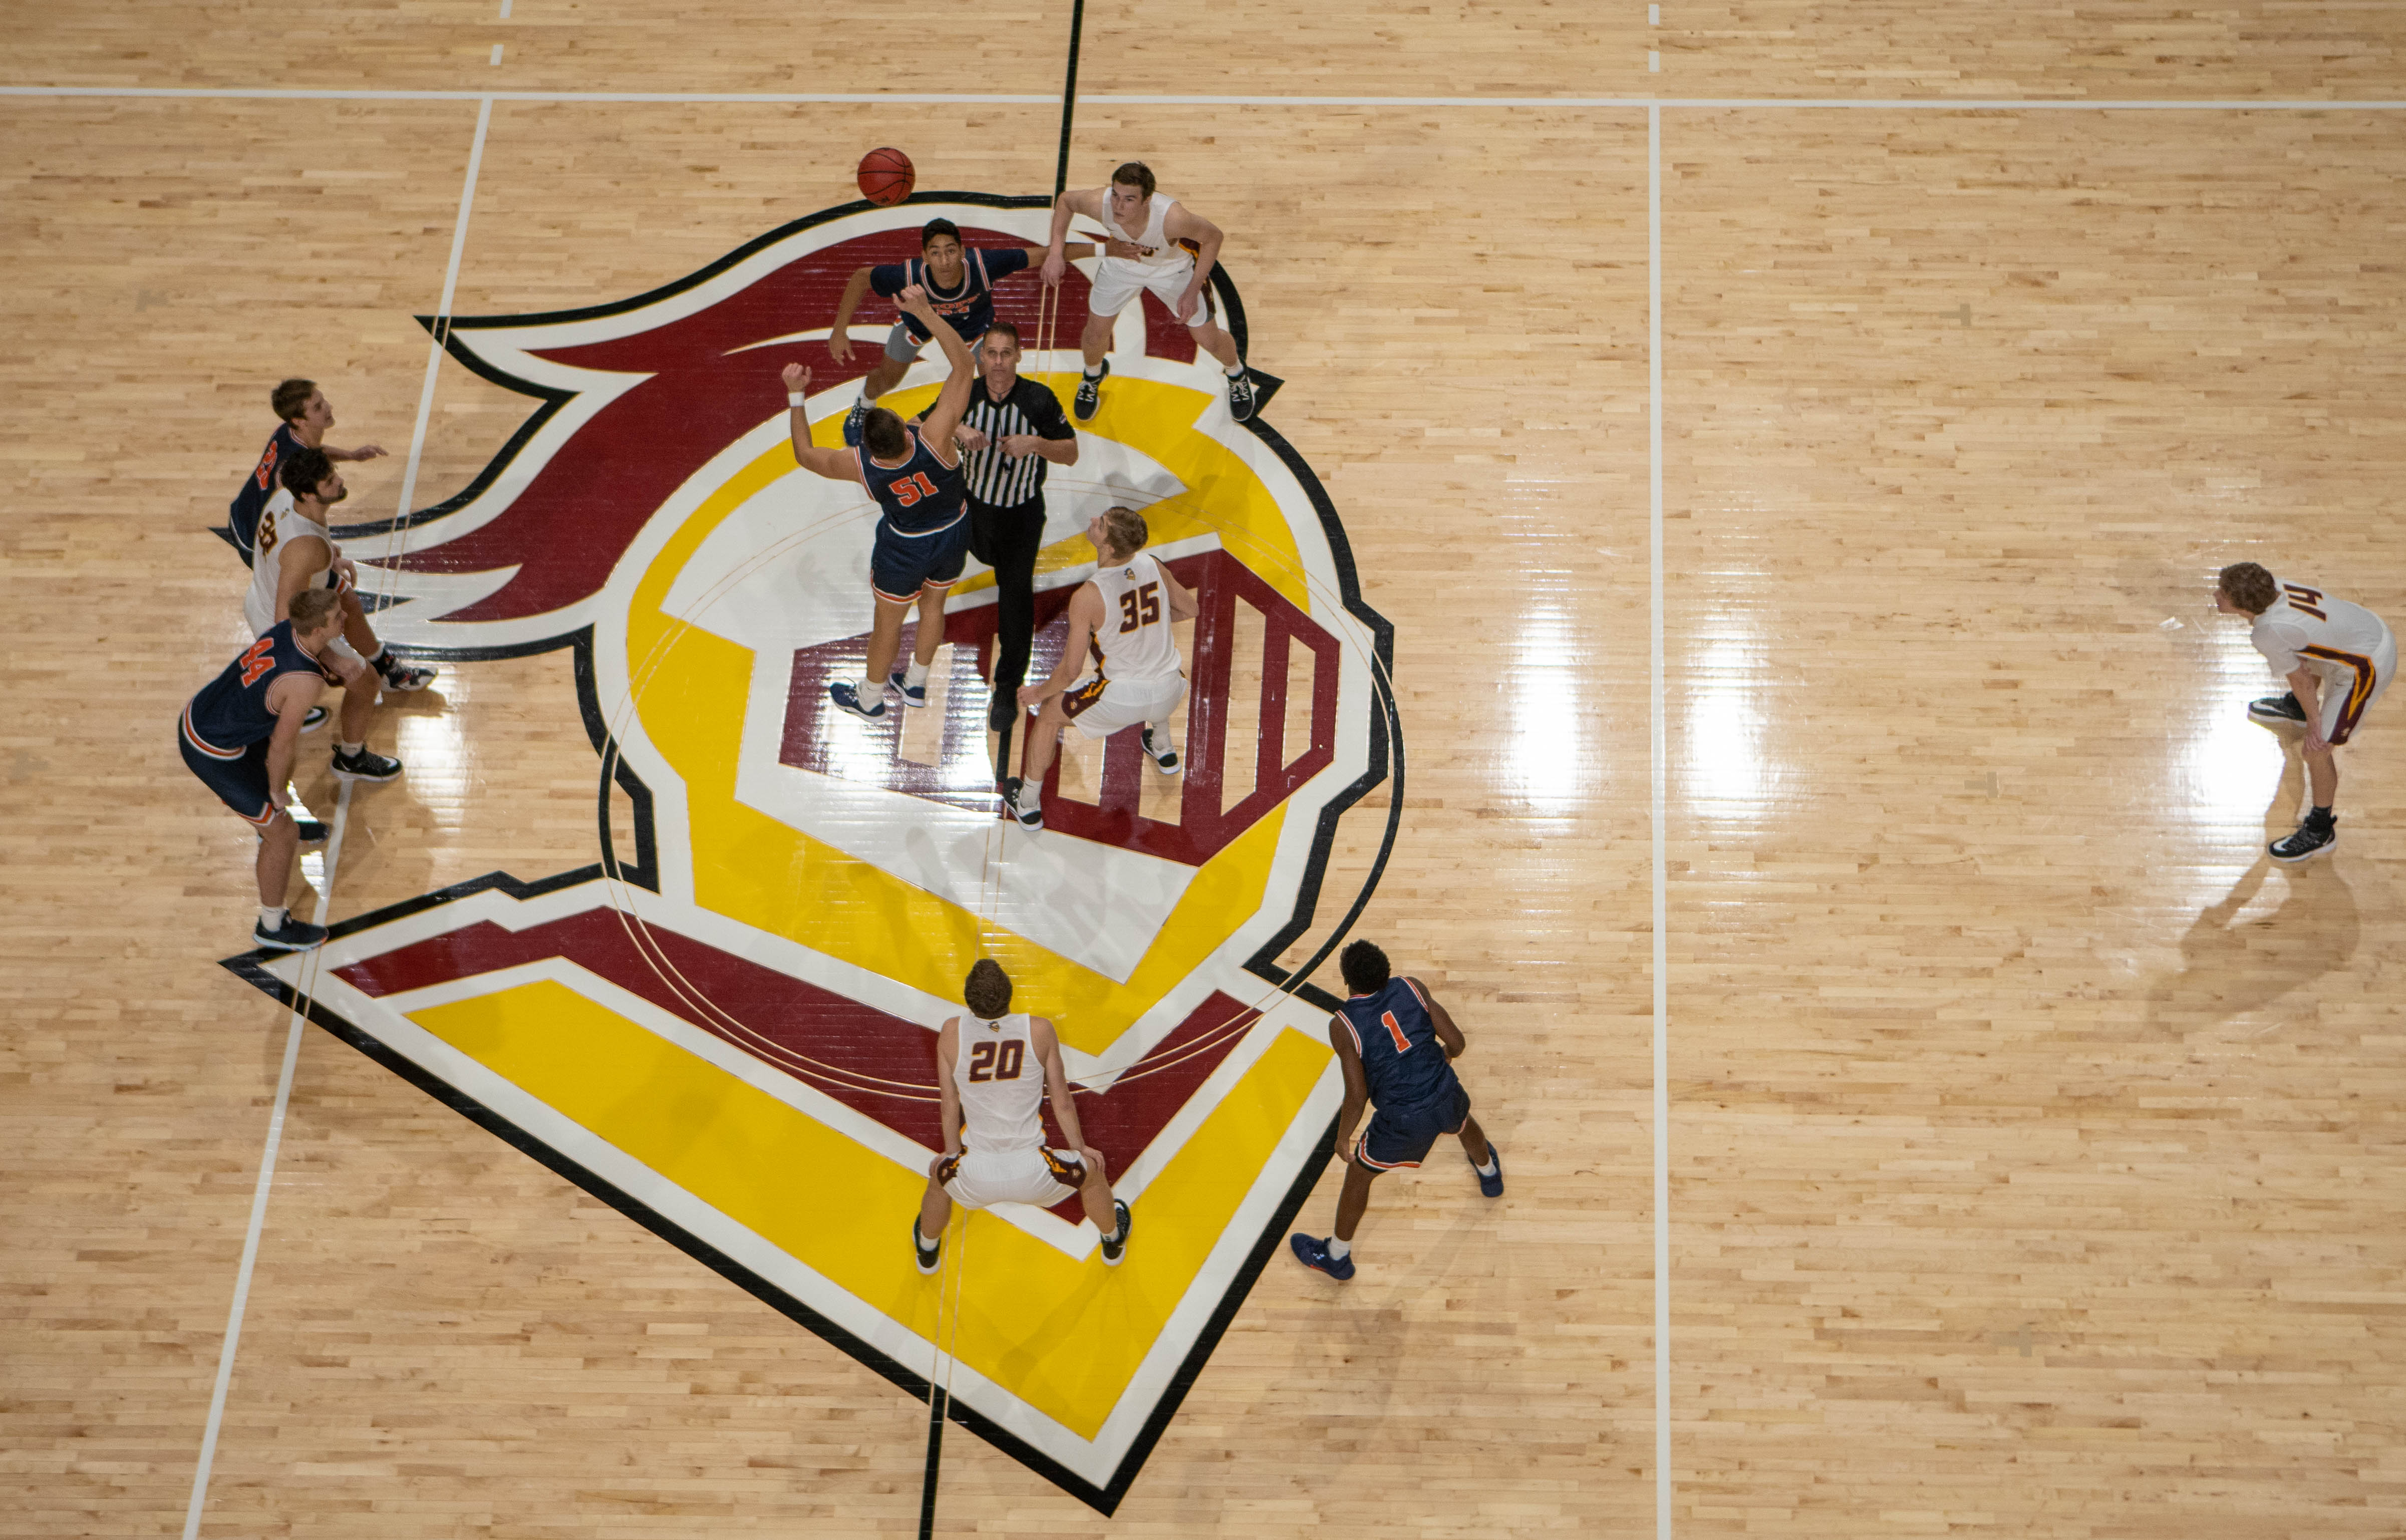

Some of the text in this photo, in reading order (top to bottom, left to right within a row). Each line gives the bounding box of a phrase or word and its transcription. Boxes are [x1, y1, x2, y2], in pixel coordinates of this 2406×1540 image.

[888, 471, 939, 507] 51
[1119, 581, 1160, 635] 35
[2283, 583, 2327, 622] 14
[239, 637, 276, 689] 44
[1381, 1010, 1412, 1054] 1
[969, 1039, 1025, 1083] 20
